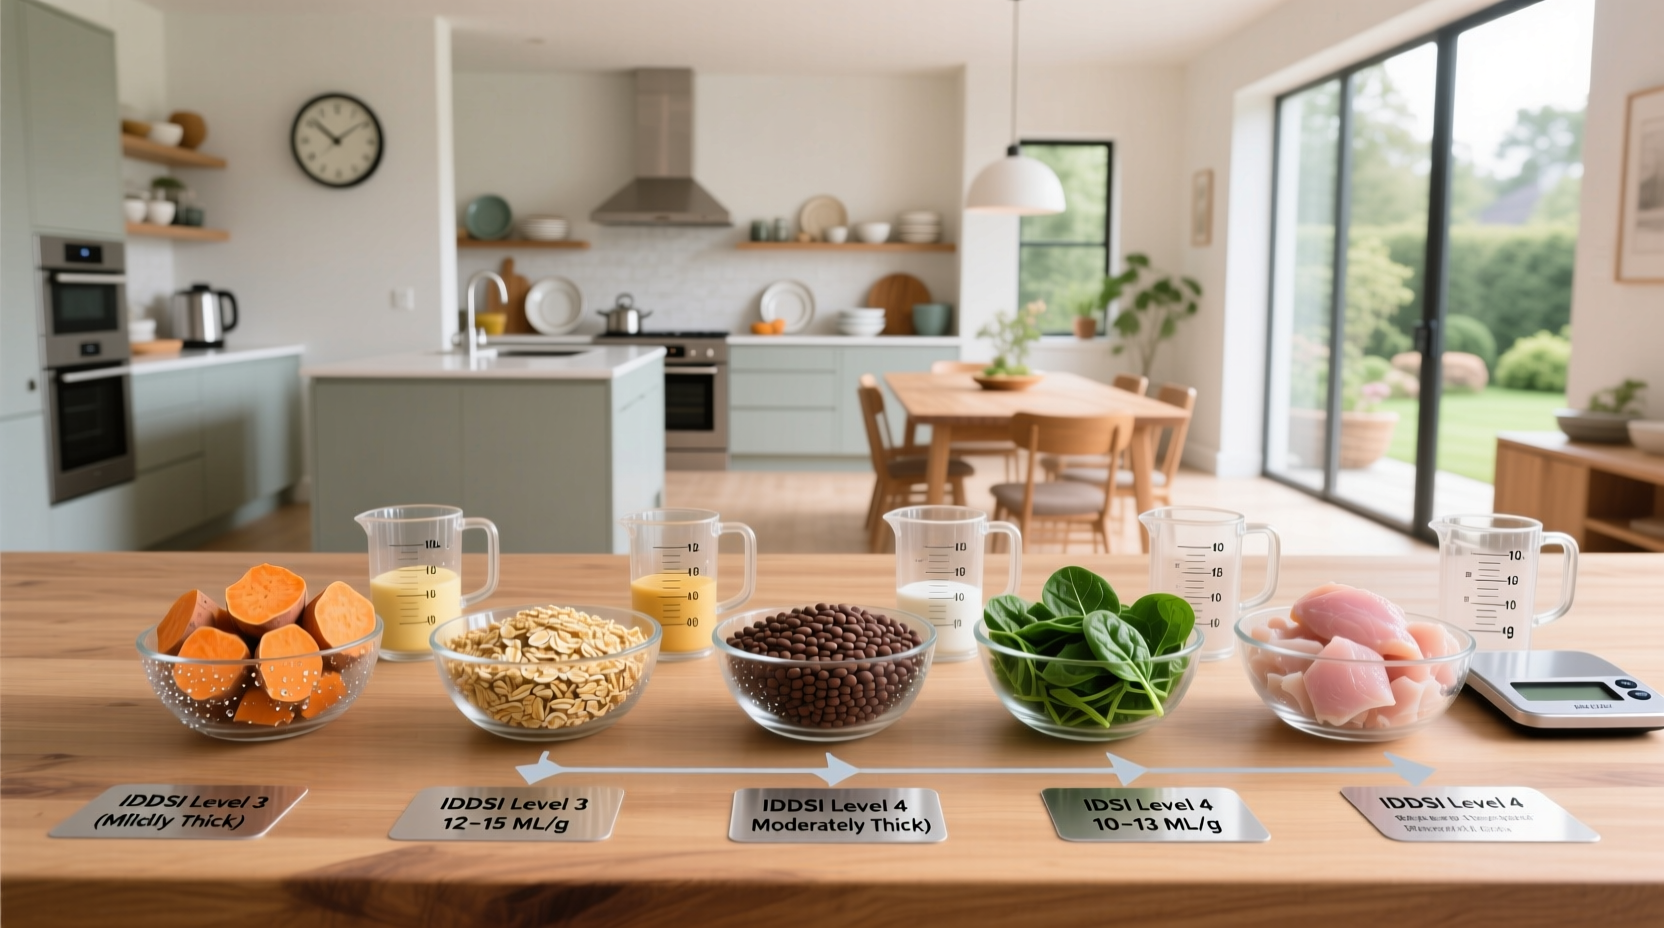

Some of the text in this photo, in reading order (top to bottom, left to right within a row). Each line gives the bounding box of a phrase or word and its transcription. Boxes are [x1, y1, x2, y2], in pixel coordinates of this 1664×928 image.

[1212, 542, 1224, 552] 10
[1210, 593, 1222, 602] 10
[1505, 600, 1516, 610] 10
[118, 794, 269, 809] IDDSI Level 3
[440, 797, 589, 811] IDDSI Level 3
[763, 799, 908, 812] IDDSI Level 4
[1083, 798, 1214, 812] IDSI Level 4
[1379, 797, 1524, 809] IDDSI Level 4
[181, 813, 245, 831] Thick)
[512, 816, 570, 834] ML/g
[751, 817, 931, 835] Moderately Thick)
[1163, 816, 1222, 834] ML/g
